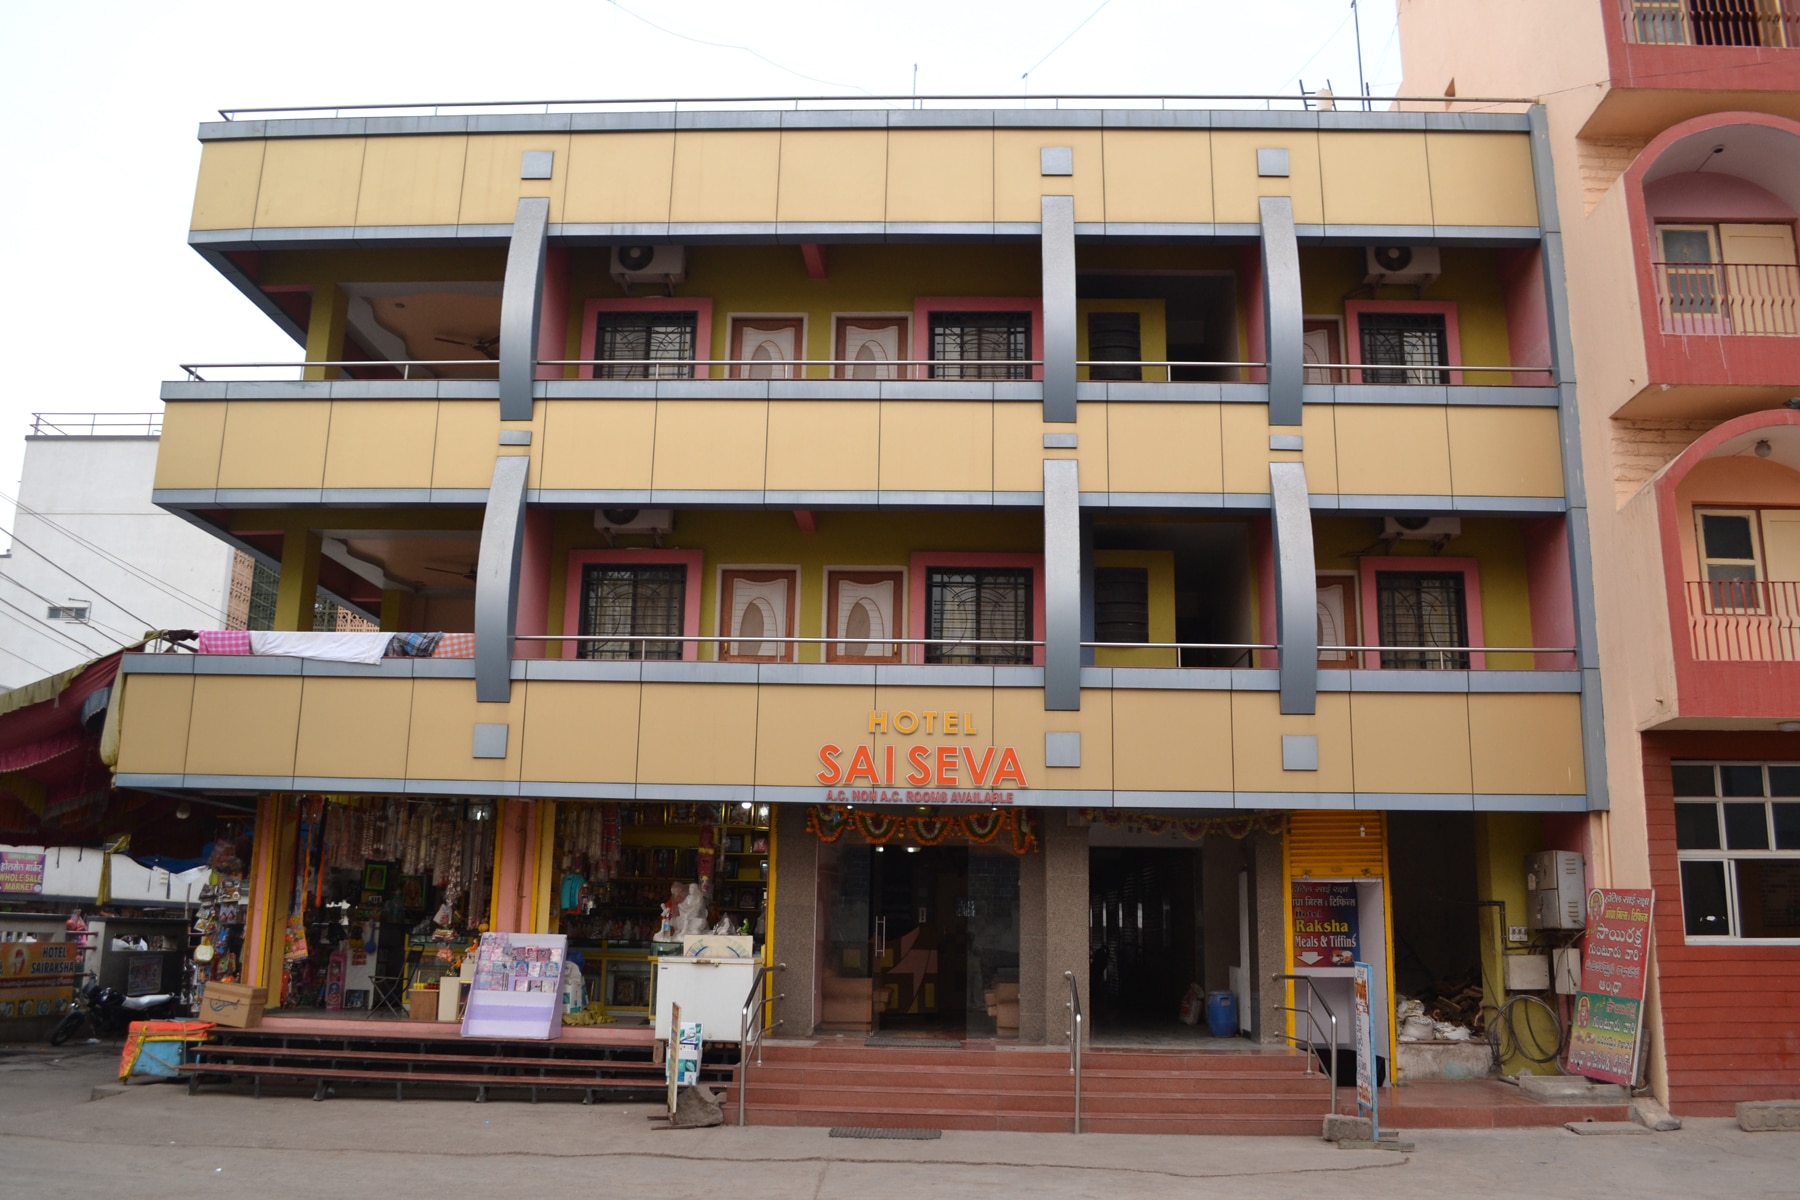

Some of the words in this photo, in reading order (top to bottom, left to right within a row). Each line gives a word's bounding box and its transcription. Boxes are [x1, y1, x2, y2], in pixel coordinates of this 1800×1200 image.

[868, 710, 977, 735] HOTEL
[816, 743, 895, 785] SAI
[906, 744, 1029, 787] SEVA
[826, 789, 849, 802] A.C.
[852, 790, 877, 802] NON
[880, 790, 903, 802] A.C.
[906, 790, 948, 803] ROOMS
[950, 791, 1014, 804] AVAILABLE
[0, 873, 24, 882] WHOLE
[25, 874, 42, 883] SALE
[5, 882, 34, 891] MARKET
[1295, 910, 1322, 918] Hotel
[1295, 919, 1349, 932] Raksha
[1295, 935, 1318, 947] Meals
[1320, 935, 1328, 947] &
[1330, 935, 1357, 947] Tiffins
[42, 946, 66, 958] HOTEL
[31, 962, 74, 974] SAIRAKSHA
